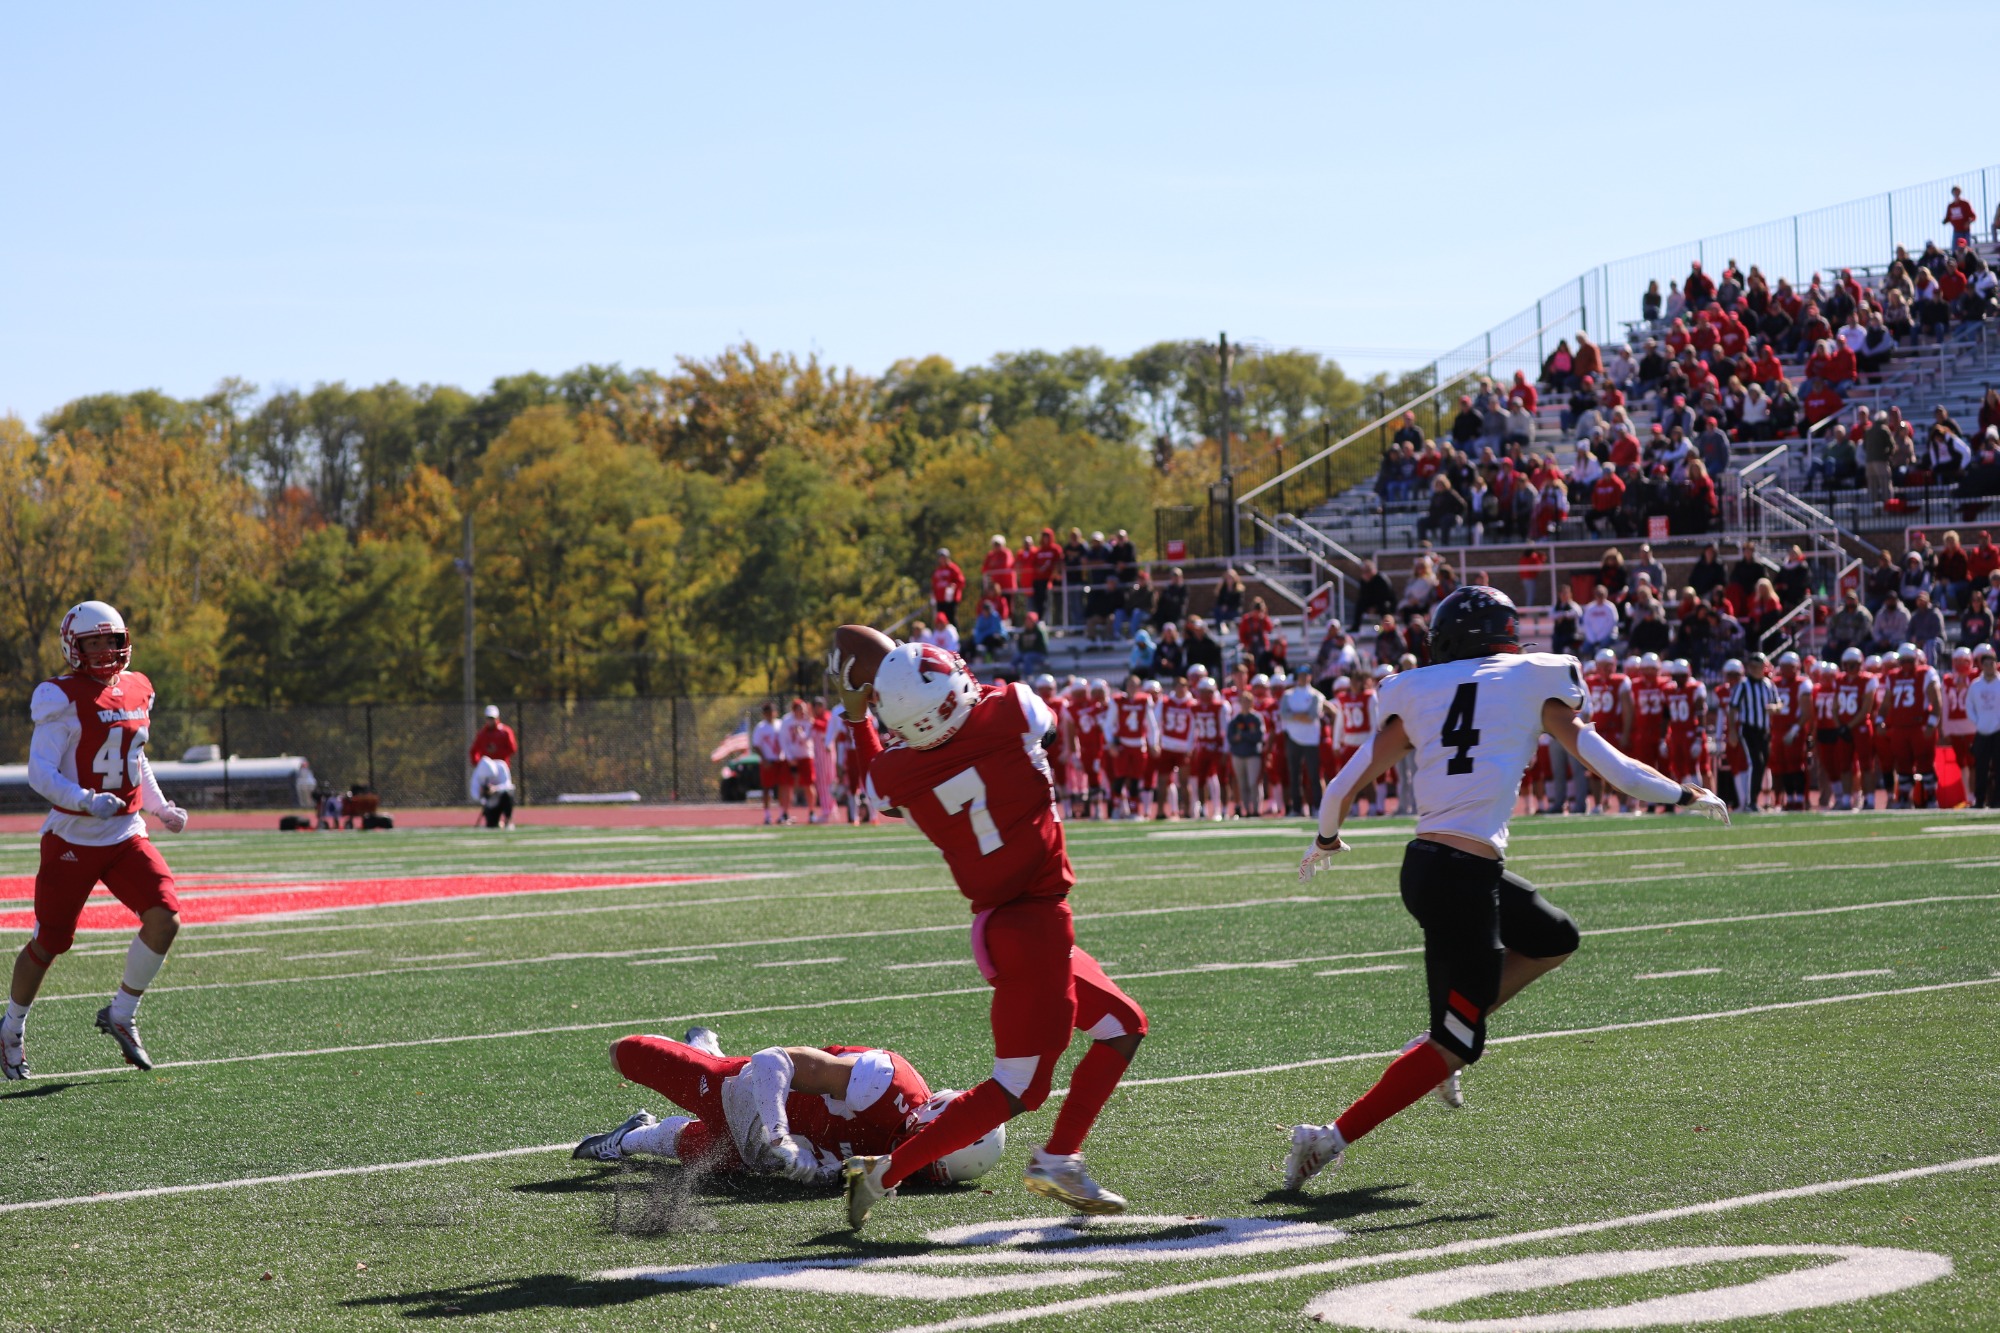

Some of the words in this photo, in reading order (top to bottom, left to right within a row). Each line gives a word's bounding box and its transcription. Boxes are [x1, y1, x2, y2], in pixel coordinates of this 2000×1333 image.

[1893, 685, 1915, 708] 73
[97, 707, 145, 723] Wabash
[1441, 682, 1481, 776] 4
[932, 766, 1005, 856] 7
[893, 1092, 910, 1115] 2
